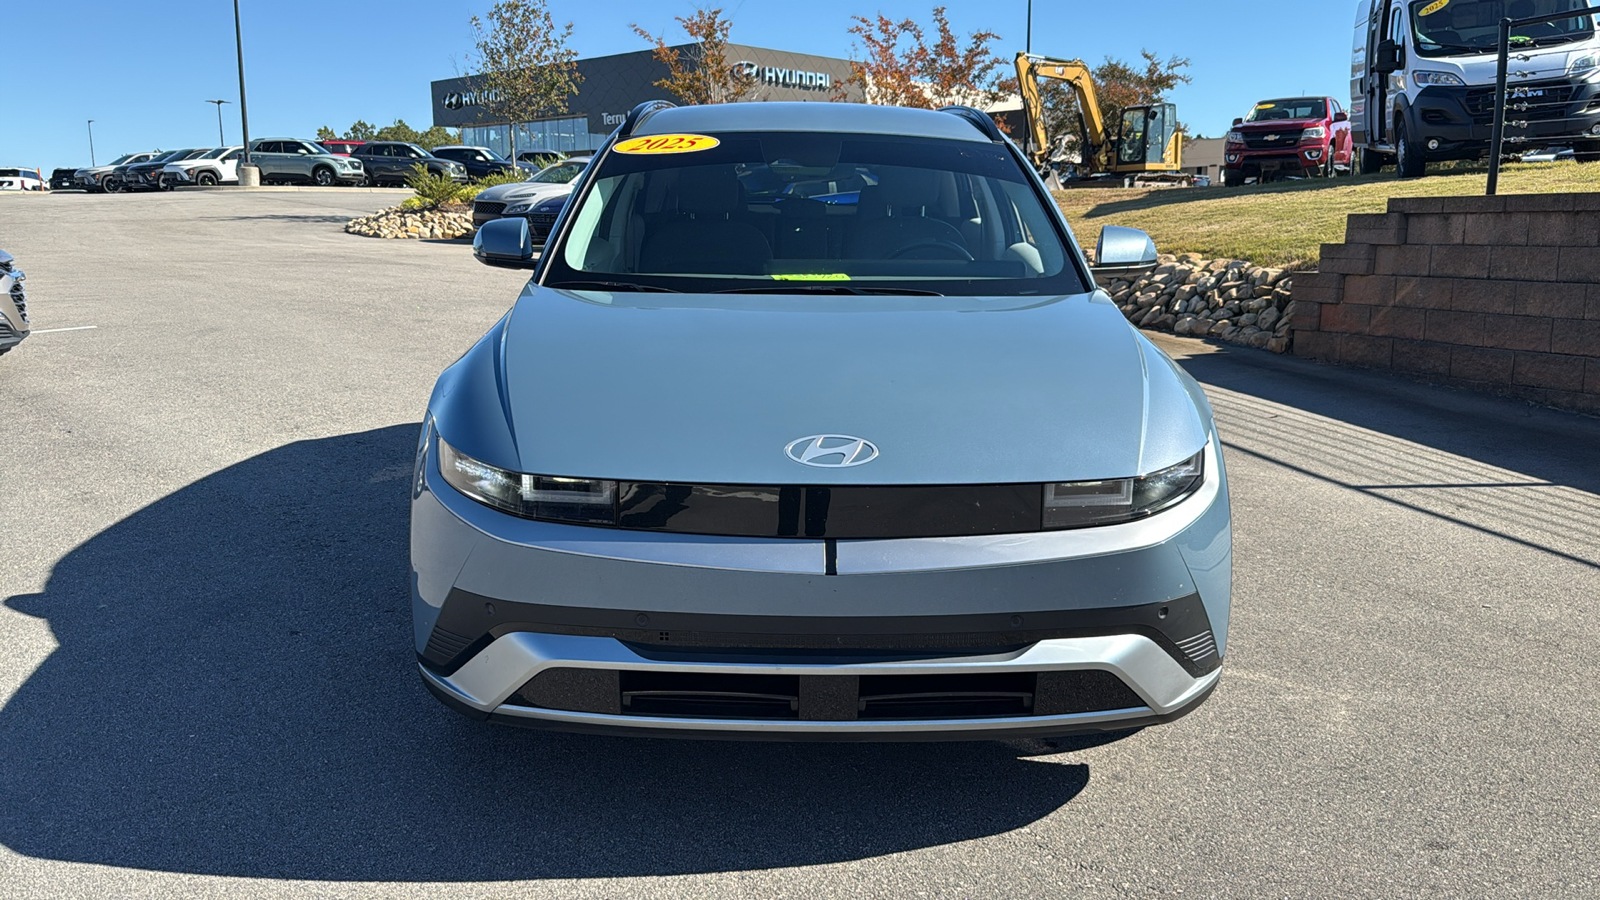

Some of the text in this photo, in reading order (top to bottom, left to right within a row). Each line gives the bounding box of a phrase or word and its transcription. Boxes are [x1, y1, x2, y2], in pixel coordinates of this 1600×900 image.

[765, 66, 830, 87] HYUNDAI
[462, 89, 510, 106] HYUND
[1493, 90, 1543, 100] AM
[627, 138, 704, 152] 2025
